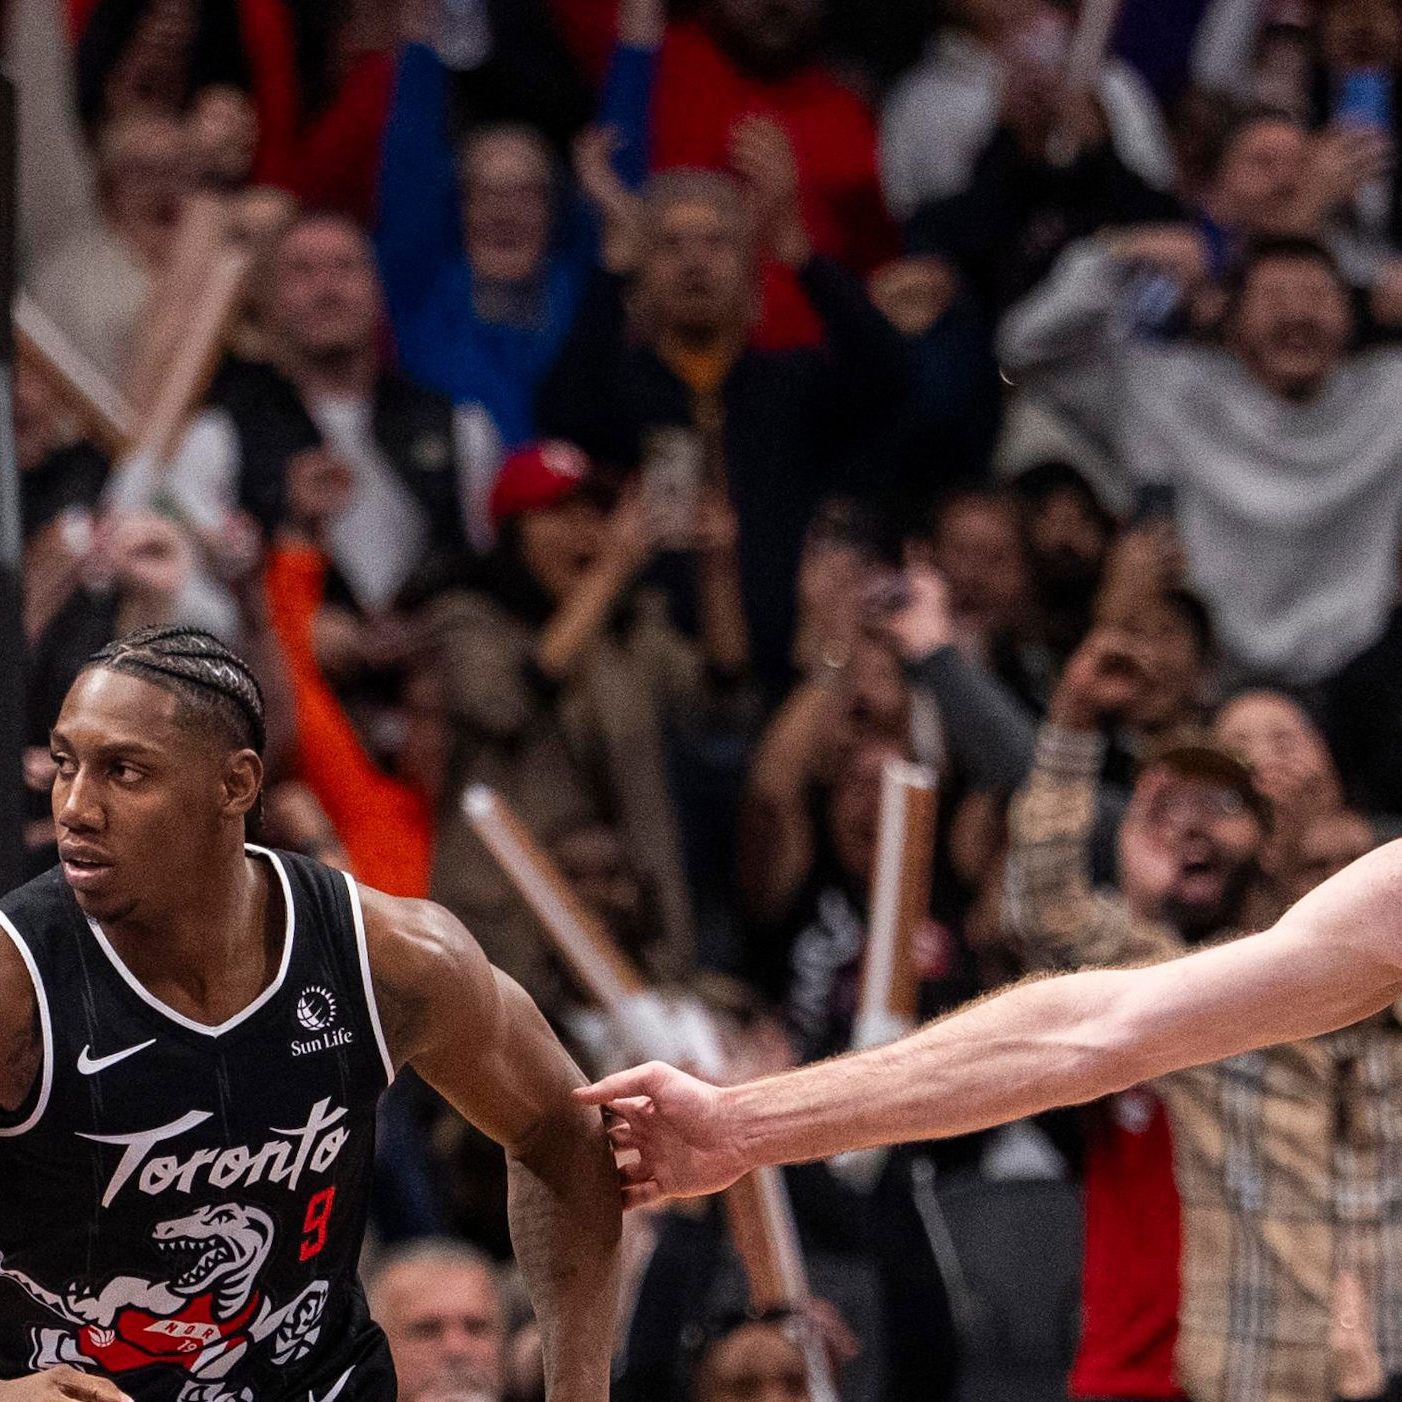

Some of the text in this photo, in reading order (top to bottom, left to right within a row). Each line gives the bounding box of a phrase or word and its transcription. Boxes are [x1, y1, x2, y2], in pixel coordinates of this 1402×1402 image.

[291, 1027, 353, 1057] Sun Life
[74, 1096, 351, 1209] Toronto
[298, 1184, 337, 1262] 9
